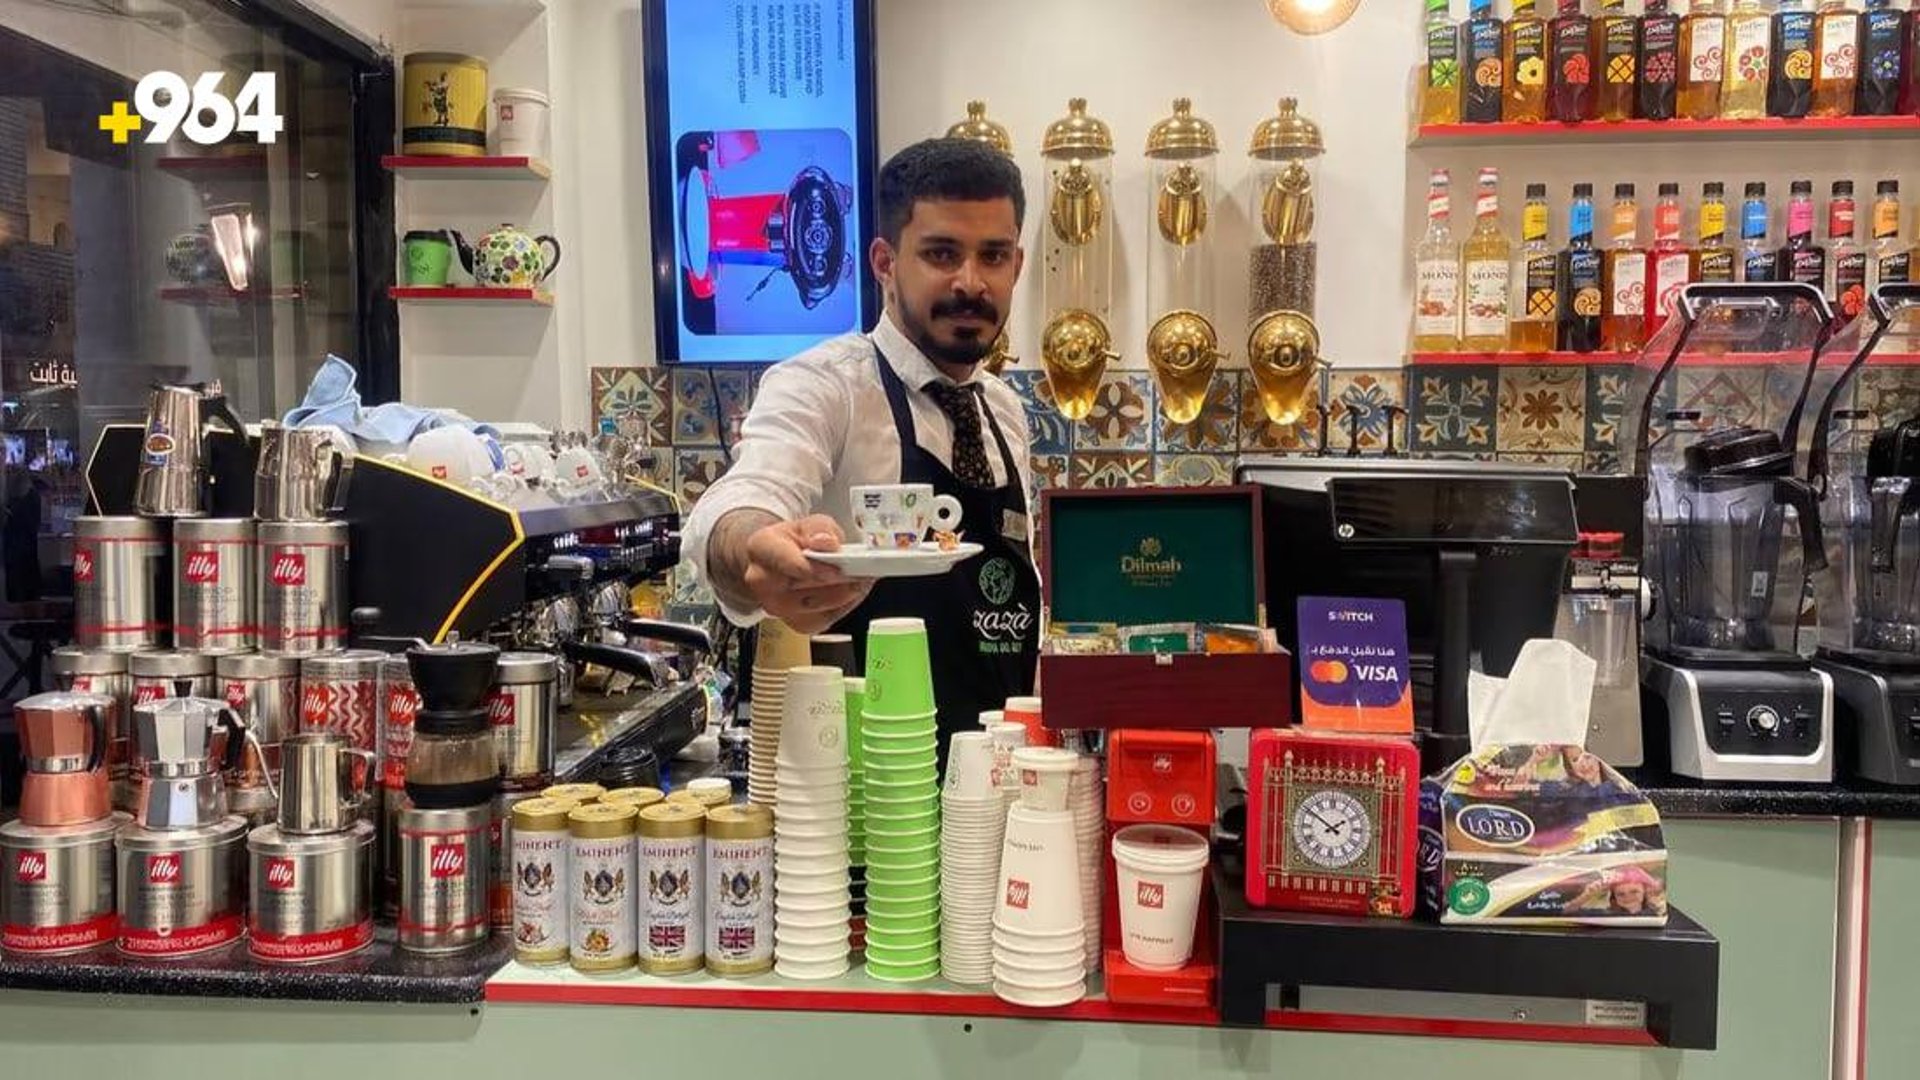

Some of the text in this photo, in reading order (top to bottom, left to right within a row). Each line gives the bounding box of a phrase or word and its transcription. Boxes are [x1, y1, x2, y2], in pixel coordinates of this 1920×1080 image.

[187, 554, 217, 578] illy
[274, 557, 303, 582] illy
[1121, 556, 1182, 573] Dilmah
[1353, 665, 1399, 682] VISA
[304, 693, 327, 713] illy
[390, 693, 414, 714] illy
[1467, 817, 1525, 838] LORD
[18, 855, 45, 879] illy
[151, 857, 178, 881] illy
[433, 850, 463, 874] illy
[269, 862, 294, 886] illy
[1139, 884, 1162, 906] illy
